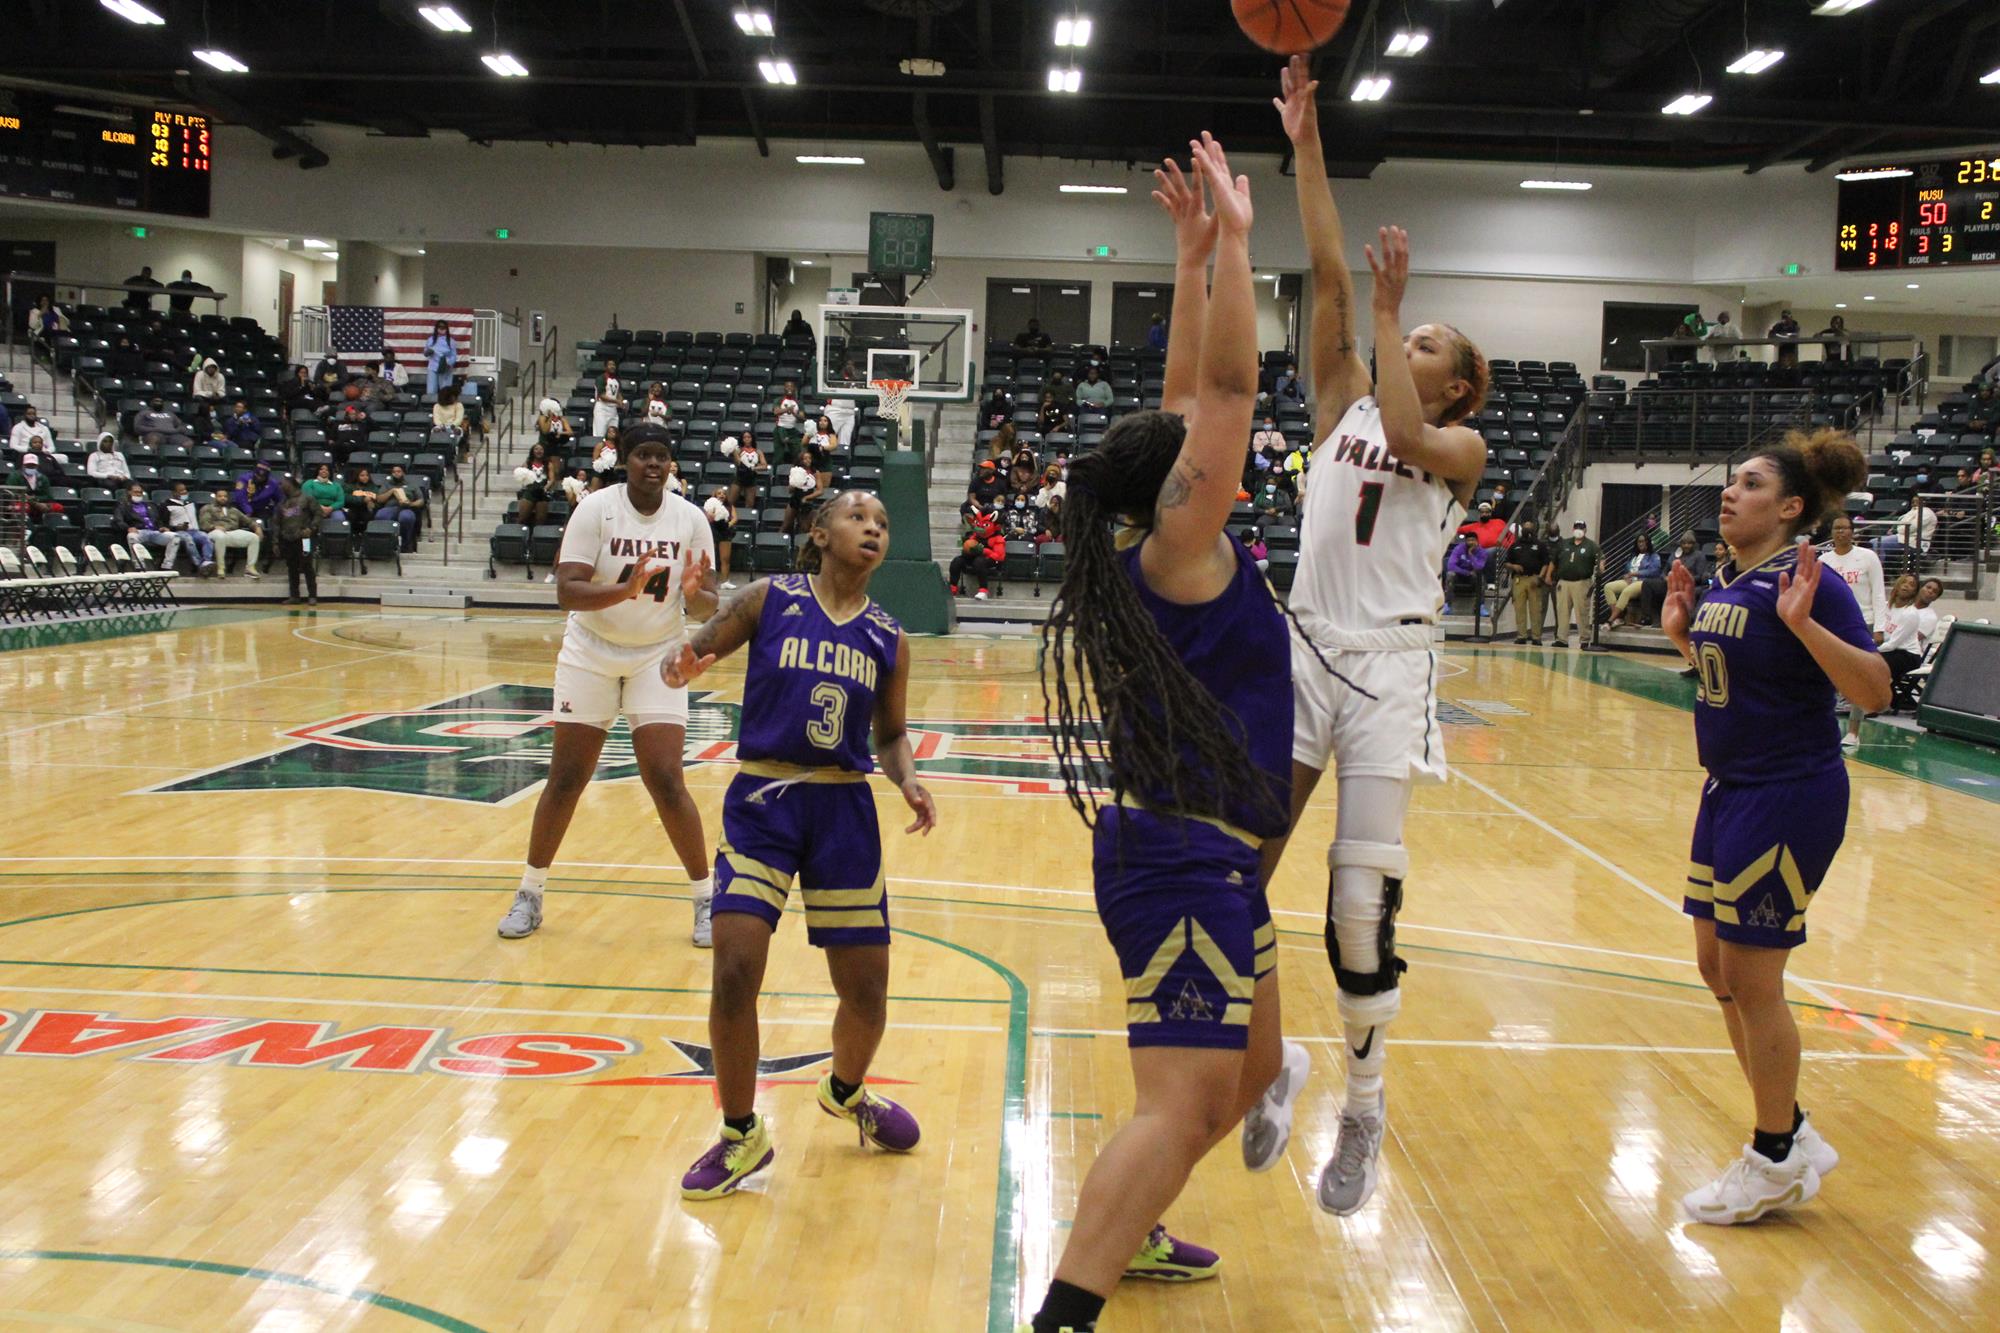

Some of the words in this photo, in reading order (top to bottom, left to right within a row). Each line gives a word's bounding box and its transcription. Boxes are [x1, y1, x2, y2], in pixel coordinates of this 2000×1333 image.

[155, 111, 171, 124] PLY
[175, 114, 187, 126] FL
[102, 130, 136, 145] ALCORN
[151, 123, 169, 138] 03
[199, 130, 209, 143] 2
[150, 151, 169, 167] 25
[199, 144, 209, 156] 9
[1919, 202, 1948, 226] 50
[1980, 201, 1993, 220] 2
[1840, 224, 1857, 239] 25
[1869, 223, 1878, 237] 2
[1889, 222, 1898, 235] 8
[1963, 224, 1988, 233] PLAYER
[1840, 239, 1857, 252] 44
[1884, 237, 1898, 250] 12
[1918, 235, 1929, 253] 3
[1942, 234, 1953, 253] 3
[1868, 252, 1877, 266] 3
[1908, 256, 1930, 265] SCORE
[1971, 252, 1996, 262] MATCH
[1355, 481, 1385, 547] 1
[1689, 602, 1750, 640] CORN
[779, 636, 878, 692] ALCORN
[1688, 640, 1730, 709] 0
[806, 681, 849, 750] 3
[0, 1008, 638, 1080] SWA
